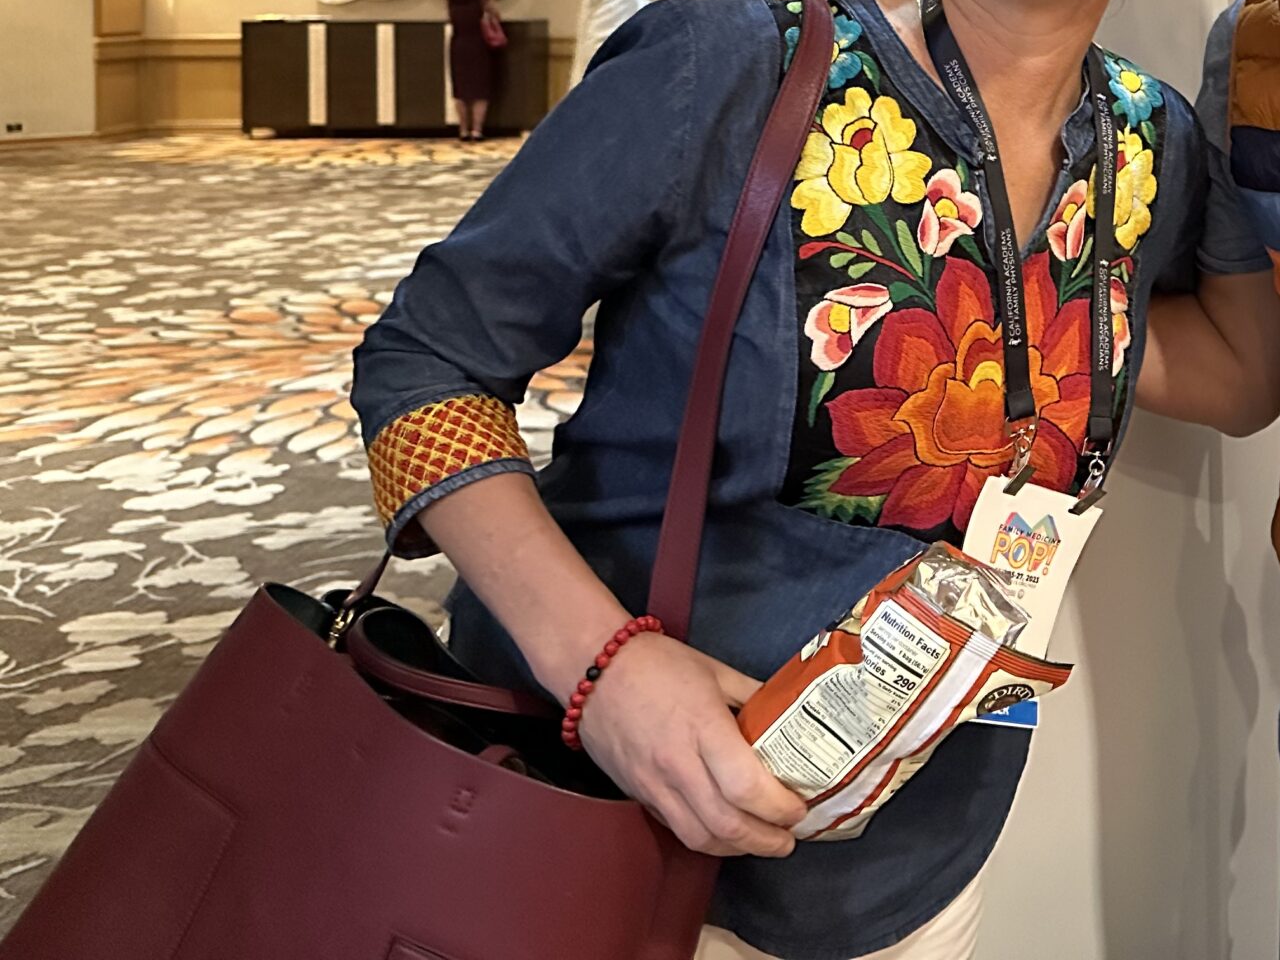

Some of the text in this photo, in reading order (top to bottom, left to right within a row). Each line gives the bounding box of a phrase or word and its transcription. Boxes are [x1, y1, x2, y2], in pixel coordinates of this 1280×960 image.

[944, 65, 968, 103] ACADEMY
[950, 60, 978, 108] PHYSICIANS
[1102, 101, 1113, 149] CALIFORNIA
[1001, 231, 1015, 336] CALIFORNIA ACADEMY
[1005, 228, 1021, 335] OF FAMILY PHYSICIANS
[990, 531, 1057, 576] POP!
[999, 524, 1061, 546] FAMILY MEDICINE
[870, 628, 886, 644] Serving
[886, 642, 896, 651] size
[902, 653, 912, 664] bag
[881, 611, 941, 660] Nutrition Facts
[864, 654, 916, 691] lories 290
